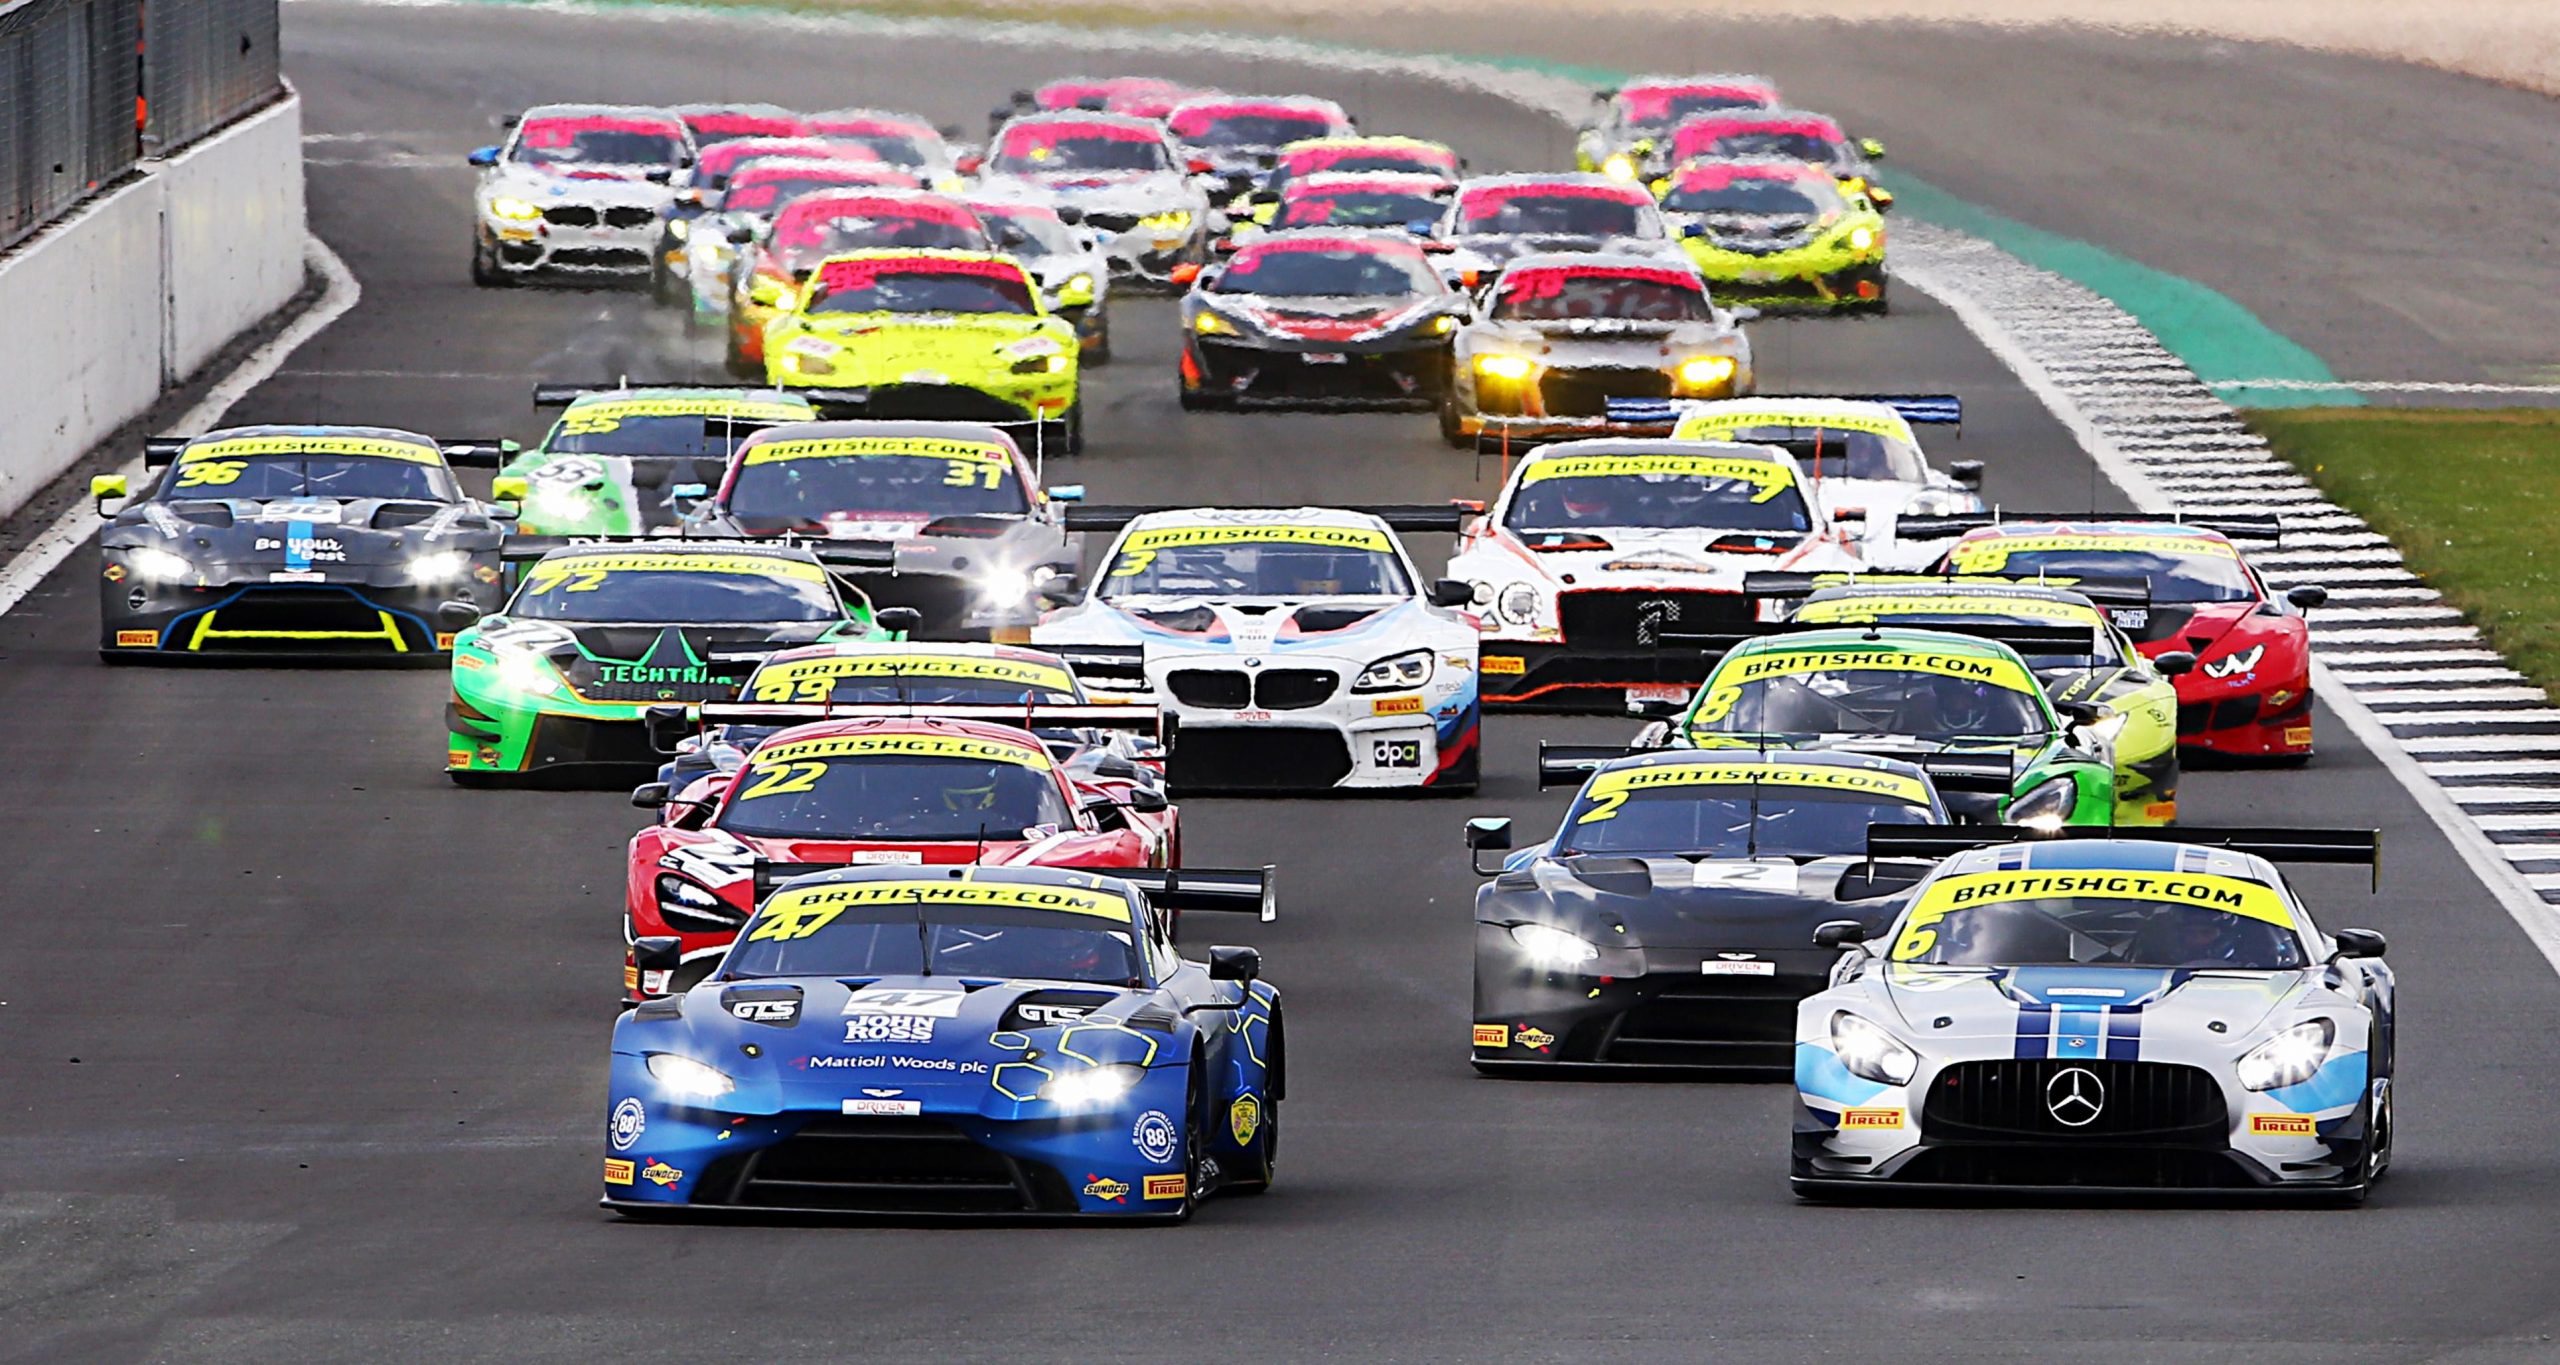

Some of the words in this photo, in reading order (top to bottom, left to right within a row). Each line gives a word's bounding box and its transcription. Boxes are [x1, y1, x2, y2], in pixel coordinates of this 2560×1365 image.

[561, 418, 620, 436] 55
[211, 441, 416, 457] BRITISHGT.COM
[770, 441, 979, 457] BRITISHGT.COM
[176, 461, 248, 487] 96
[943, 461, 1002, 490] 31
[1555, 460, 1769, 478] BRITISHGT.COM
[1749, 480, 1796, 503] 7
[255, 538, 281, 550] Be
[1143, 529, 1372, 546] BRITISHGT.COM
[300, 550, 347, 562] Best
[1110, 551, 1156, 577] 3
[1953, 551, 2008, 573] 18
[562, 559, 789, 574] BRITISHGT.COM
[529, 571, 608, 596] 72
[1834, 602, 2071, 617] BRITISHGT.COM
[790, 662, 1042, 681] BRITISHGT.COM
[1744, 653, 1993, 677] BRITISHGT.COM
[1693, 686, 1743, 724] 8
[1234, 711, 1271, 720] DRIVEN
[766, 739, 1031, 760] BRITISHGT.COM
[1375, 740, 1415, 767] dpa
[740, 762, 829, 800] 22
[1628, 769, 1900, 792] BRITISHGT.COM
[1577, 791, 1630, 825] 2
[1721, 866, 1769, 880] 2
[800, 887, 1097, 910] BRITISHGT.COM
[1953, 876, 2244, 908] BRITISHGT.COM
[748, 905, 846, 942] 47
[1892, 913, 1943, 961] 6
[1716, 962, 1760, 972] DRIVEN
[861, 992, 945, 1007] 47
[733, 1001, 798, 1018] GTS
[1018, 1004, 1084, 1023] GTS
[846, 1015, 936, 1027] JOHN
[845, 1026, 932, 1040] ROSS
[1516, 1034, 1552, 1043] SUNOCO
[810, 1055, 886, 1068] Mattioli
[890, 1057, 956, 1071] Woods
[960, 1060, 988, 1074] plc
[857, 1101, 905, 1112] DRIVEN
[618, 1114, 636, 1133] 88
[1844, 1109, 1900, 1126] PIRELLI
[2253, 1116, 2311, 1133] PIRELLI
[1146, 1128, 1166, 1146] 88
[606, 1164, 630, 1179] RELLI
[644, 1169, 680, 1180] SUNOCO
[1086, 1184, 1127, 1194] SUNOCO
